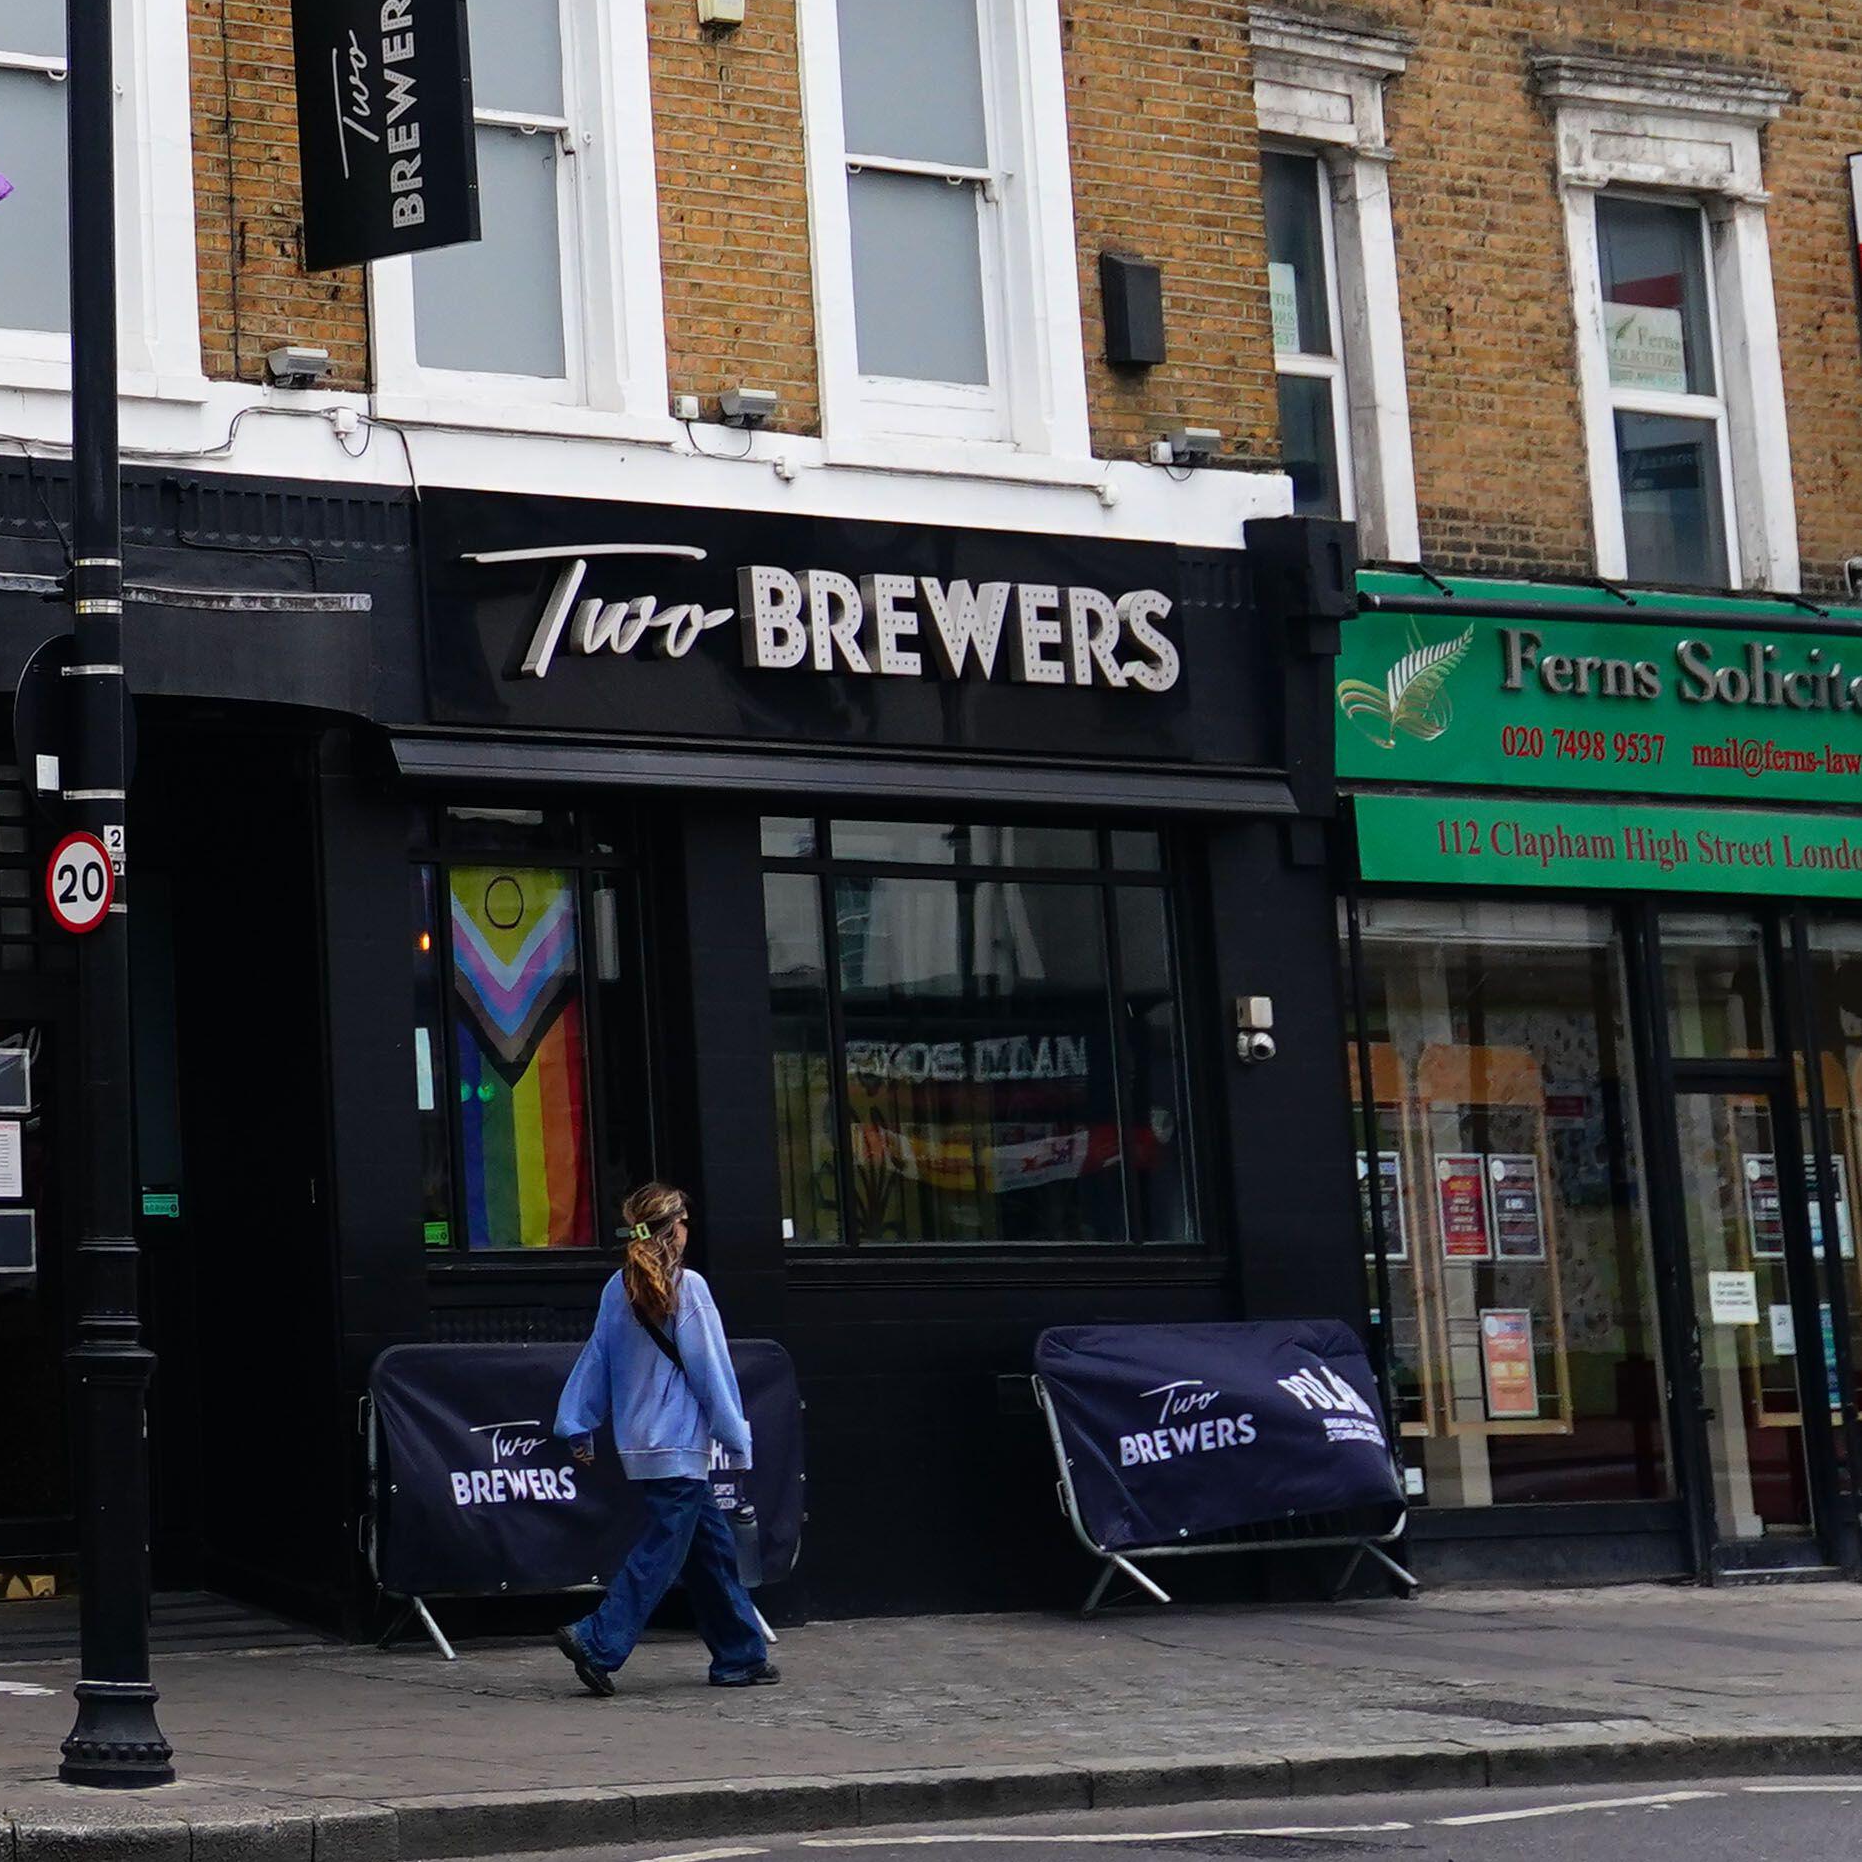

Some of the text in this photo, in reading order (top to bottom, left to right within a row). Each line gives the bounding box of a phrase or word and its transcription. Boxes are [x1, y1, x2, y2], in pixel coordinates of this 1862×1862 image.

[332, 29, 380, 179] Two
[460, 543, 1180, 692] Two BREWERS
[1499, 627, 1662, 700] Ferns
[1501, 726, 1544, 759] 020
[1552, 728, 1606, 762] 7498
[1613, 731, 1666, 765] 9537
[110, 829, 121, 847] 2
[1437, 820, 1481, 857] 112
[1489, 821, 1616, 869] Clapham
[1623, 826, 1688, 873] High
[1697, 830, 1775, 869] Street
[58, 861, 104, 904] 20
[1140, 1381, 1220, 1424] Two
[469, 1420, 547, 1463] Two
[1119, 1414, 1257, 1467] BREWERS
[450, 1466, 576, 1506] BREWERS
